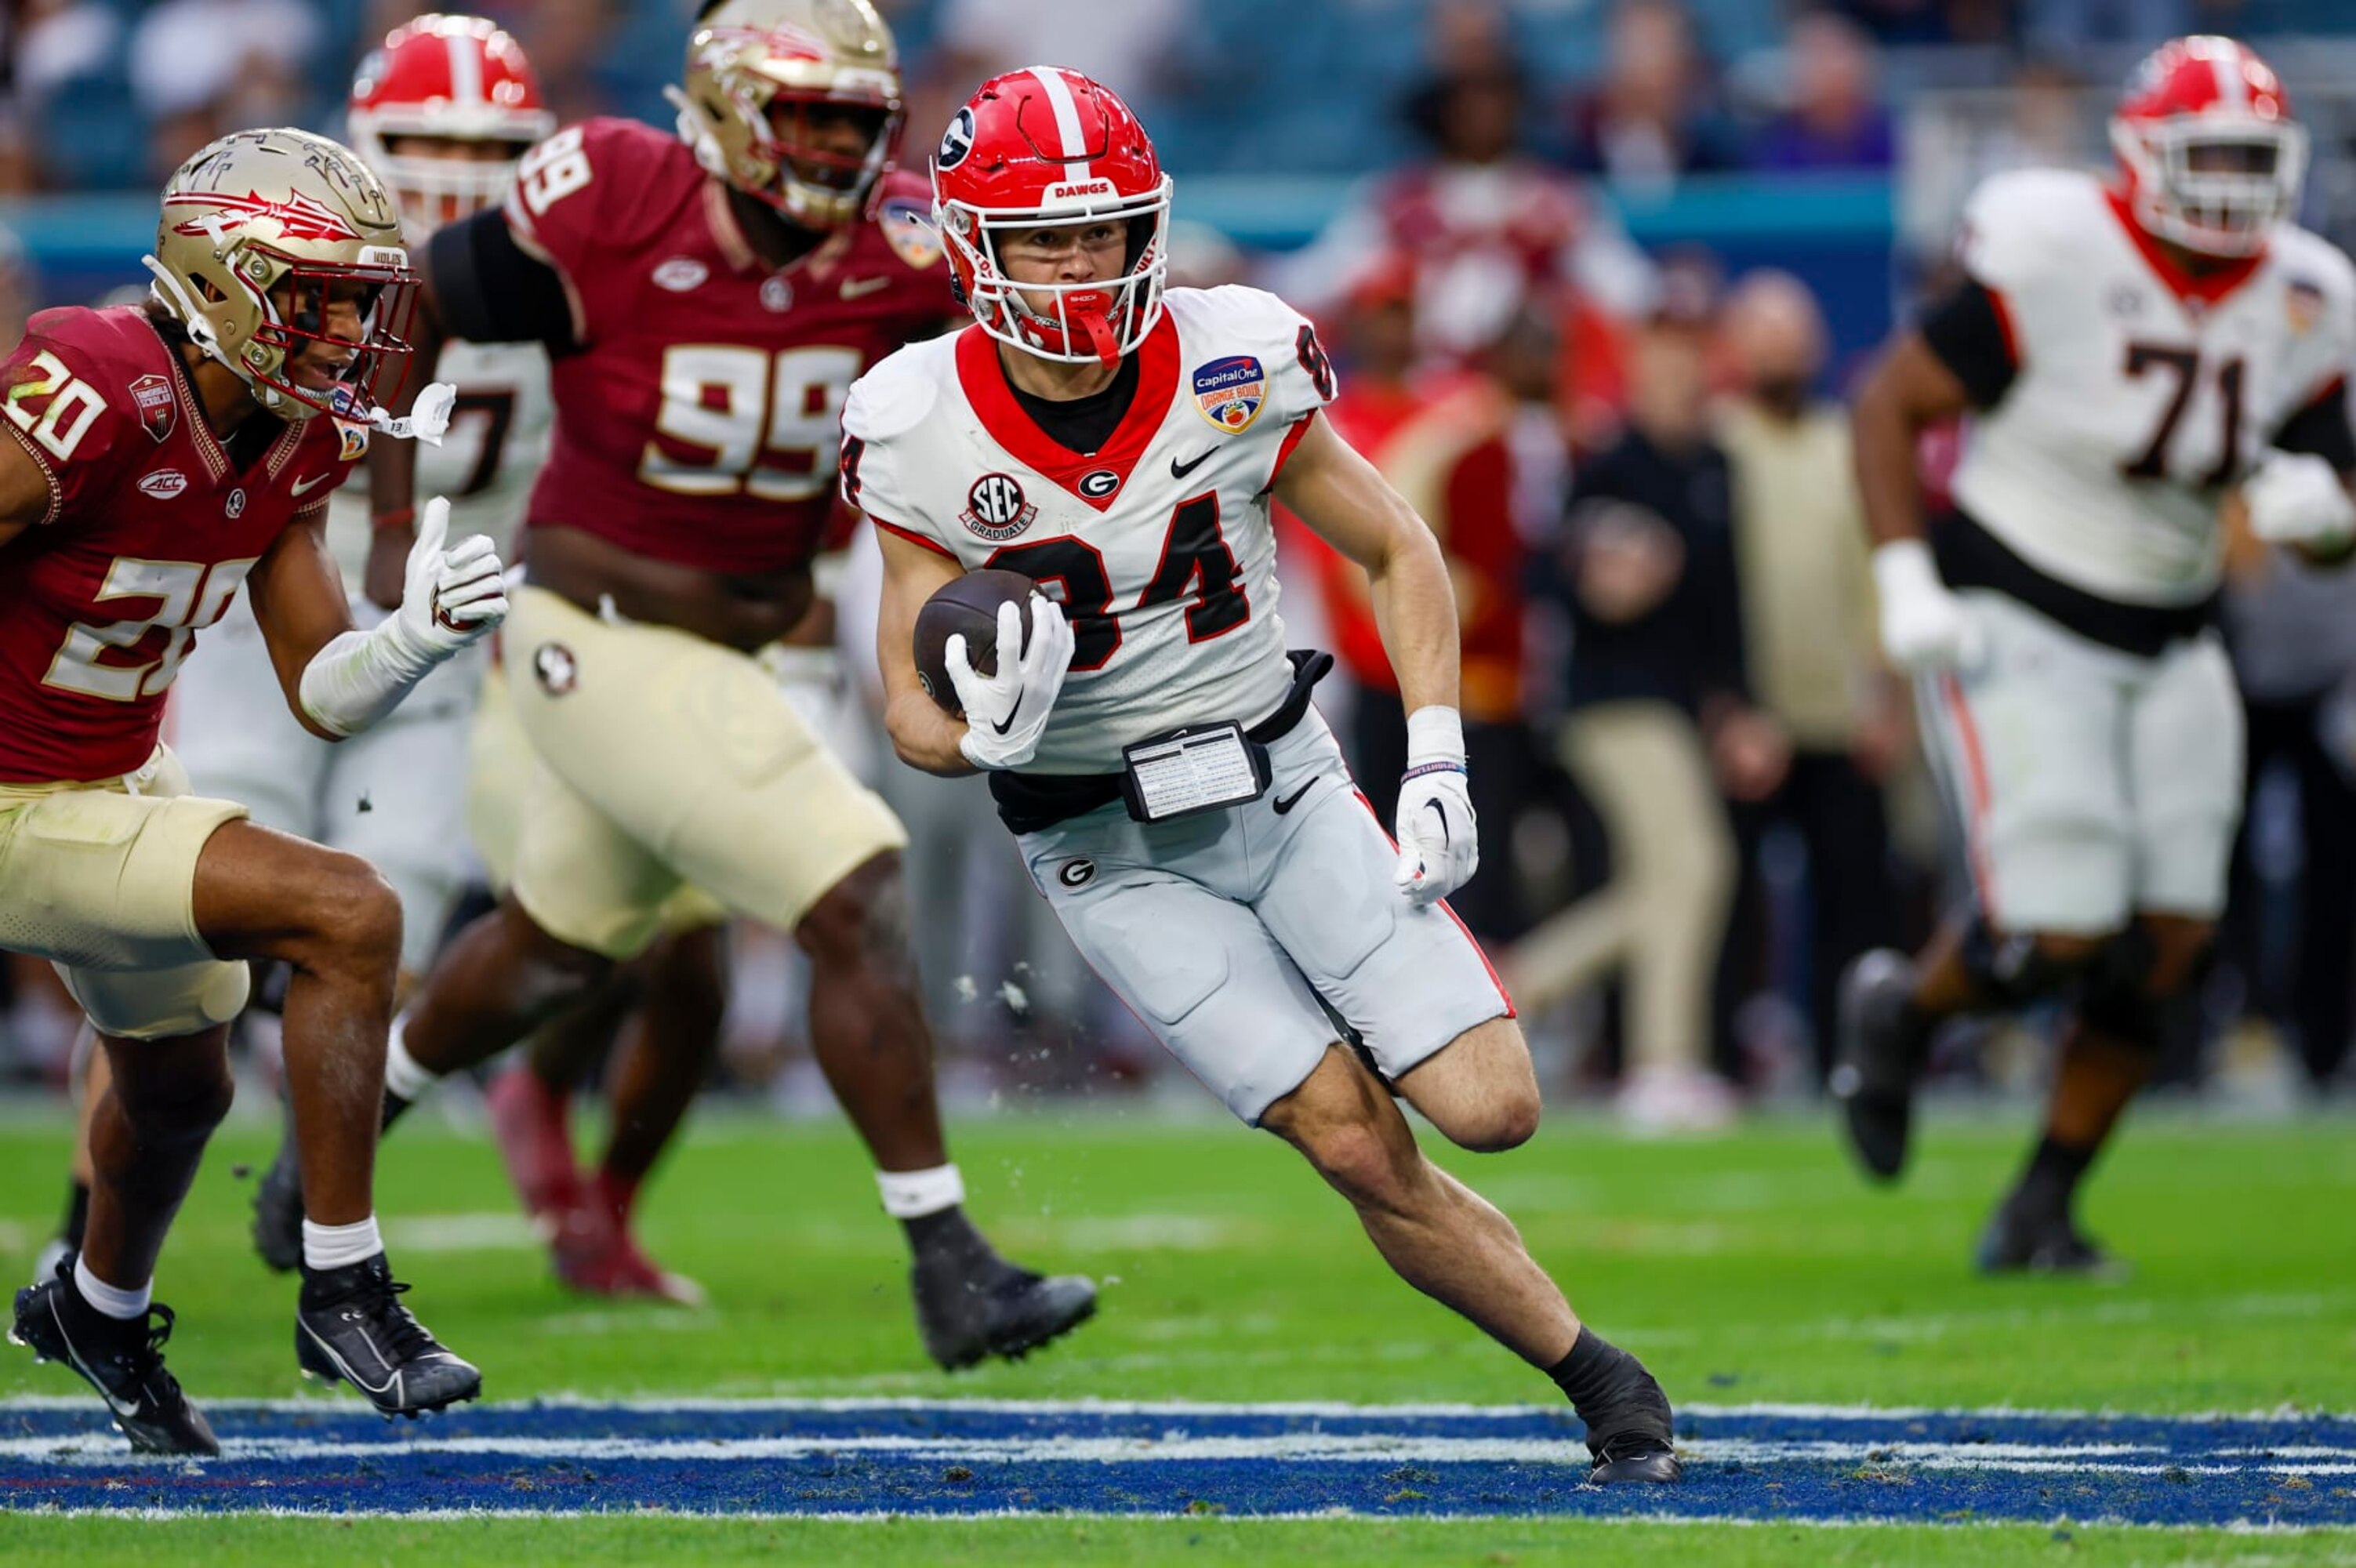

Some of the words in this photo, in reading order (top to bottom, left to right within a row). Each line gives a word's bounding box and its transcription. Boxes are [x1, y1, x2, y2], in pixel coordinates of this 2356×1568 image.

[1055, 182, 1109, 199] DAWGS
[0, 349, 108, 462] 20
[1201, 389, 1236, 411] ORANGE
[1236, 383, 1263, 398] BOWL
[2125, 341, 2245, 486] 71
[637, 343, 864, 501] 99
[972, 477, 1020, 524] SEC
[970, 516, 1029, 539] GRADUATE
